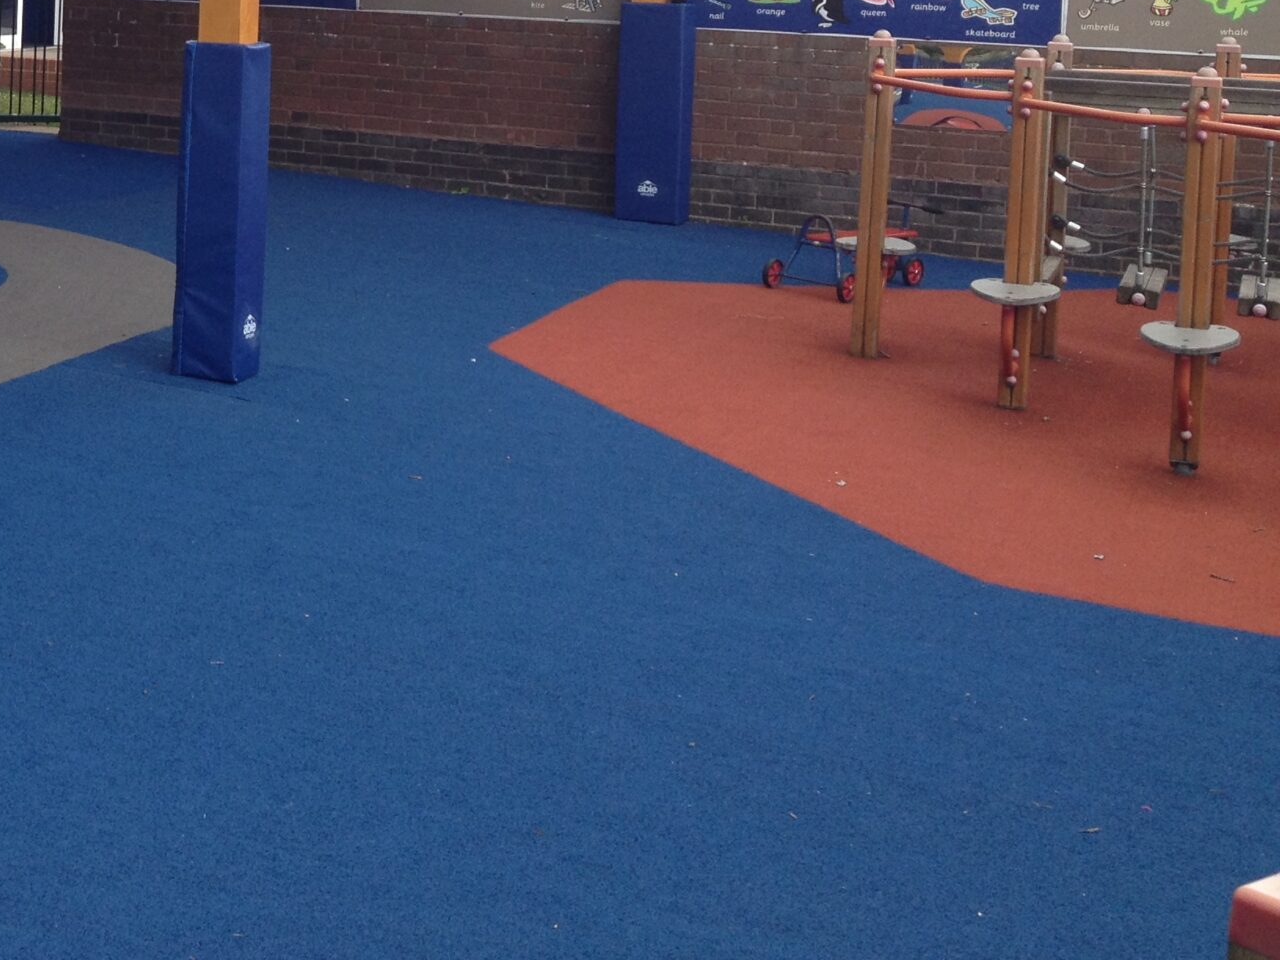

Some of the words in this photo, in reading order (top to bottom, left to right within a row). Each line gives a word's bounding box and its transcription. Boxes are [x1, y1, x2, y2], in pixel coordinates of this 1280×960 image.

[911, 3, 947, 12] rainbow
[1022, 3, 1040, 11] tree
[709, 11, 725, 19] nail
[756, 8, 786, 17] orange
[1080, 23, 1120, 32] umbrella
[1219, 28, 1249, 36] whale
[965, 29, 1016, 39] skateboard
